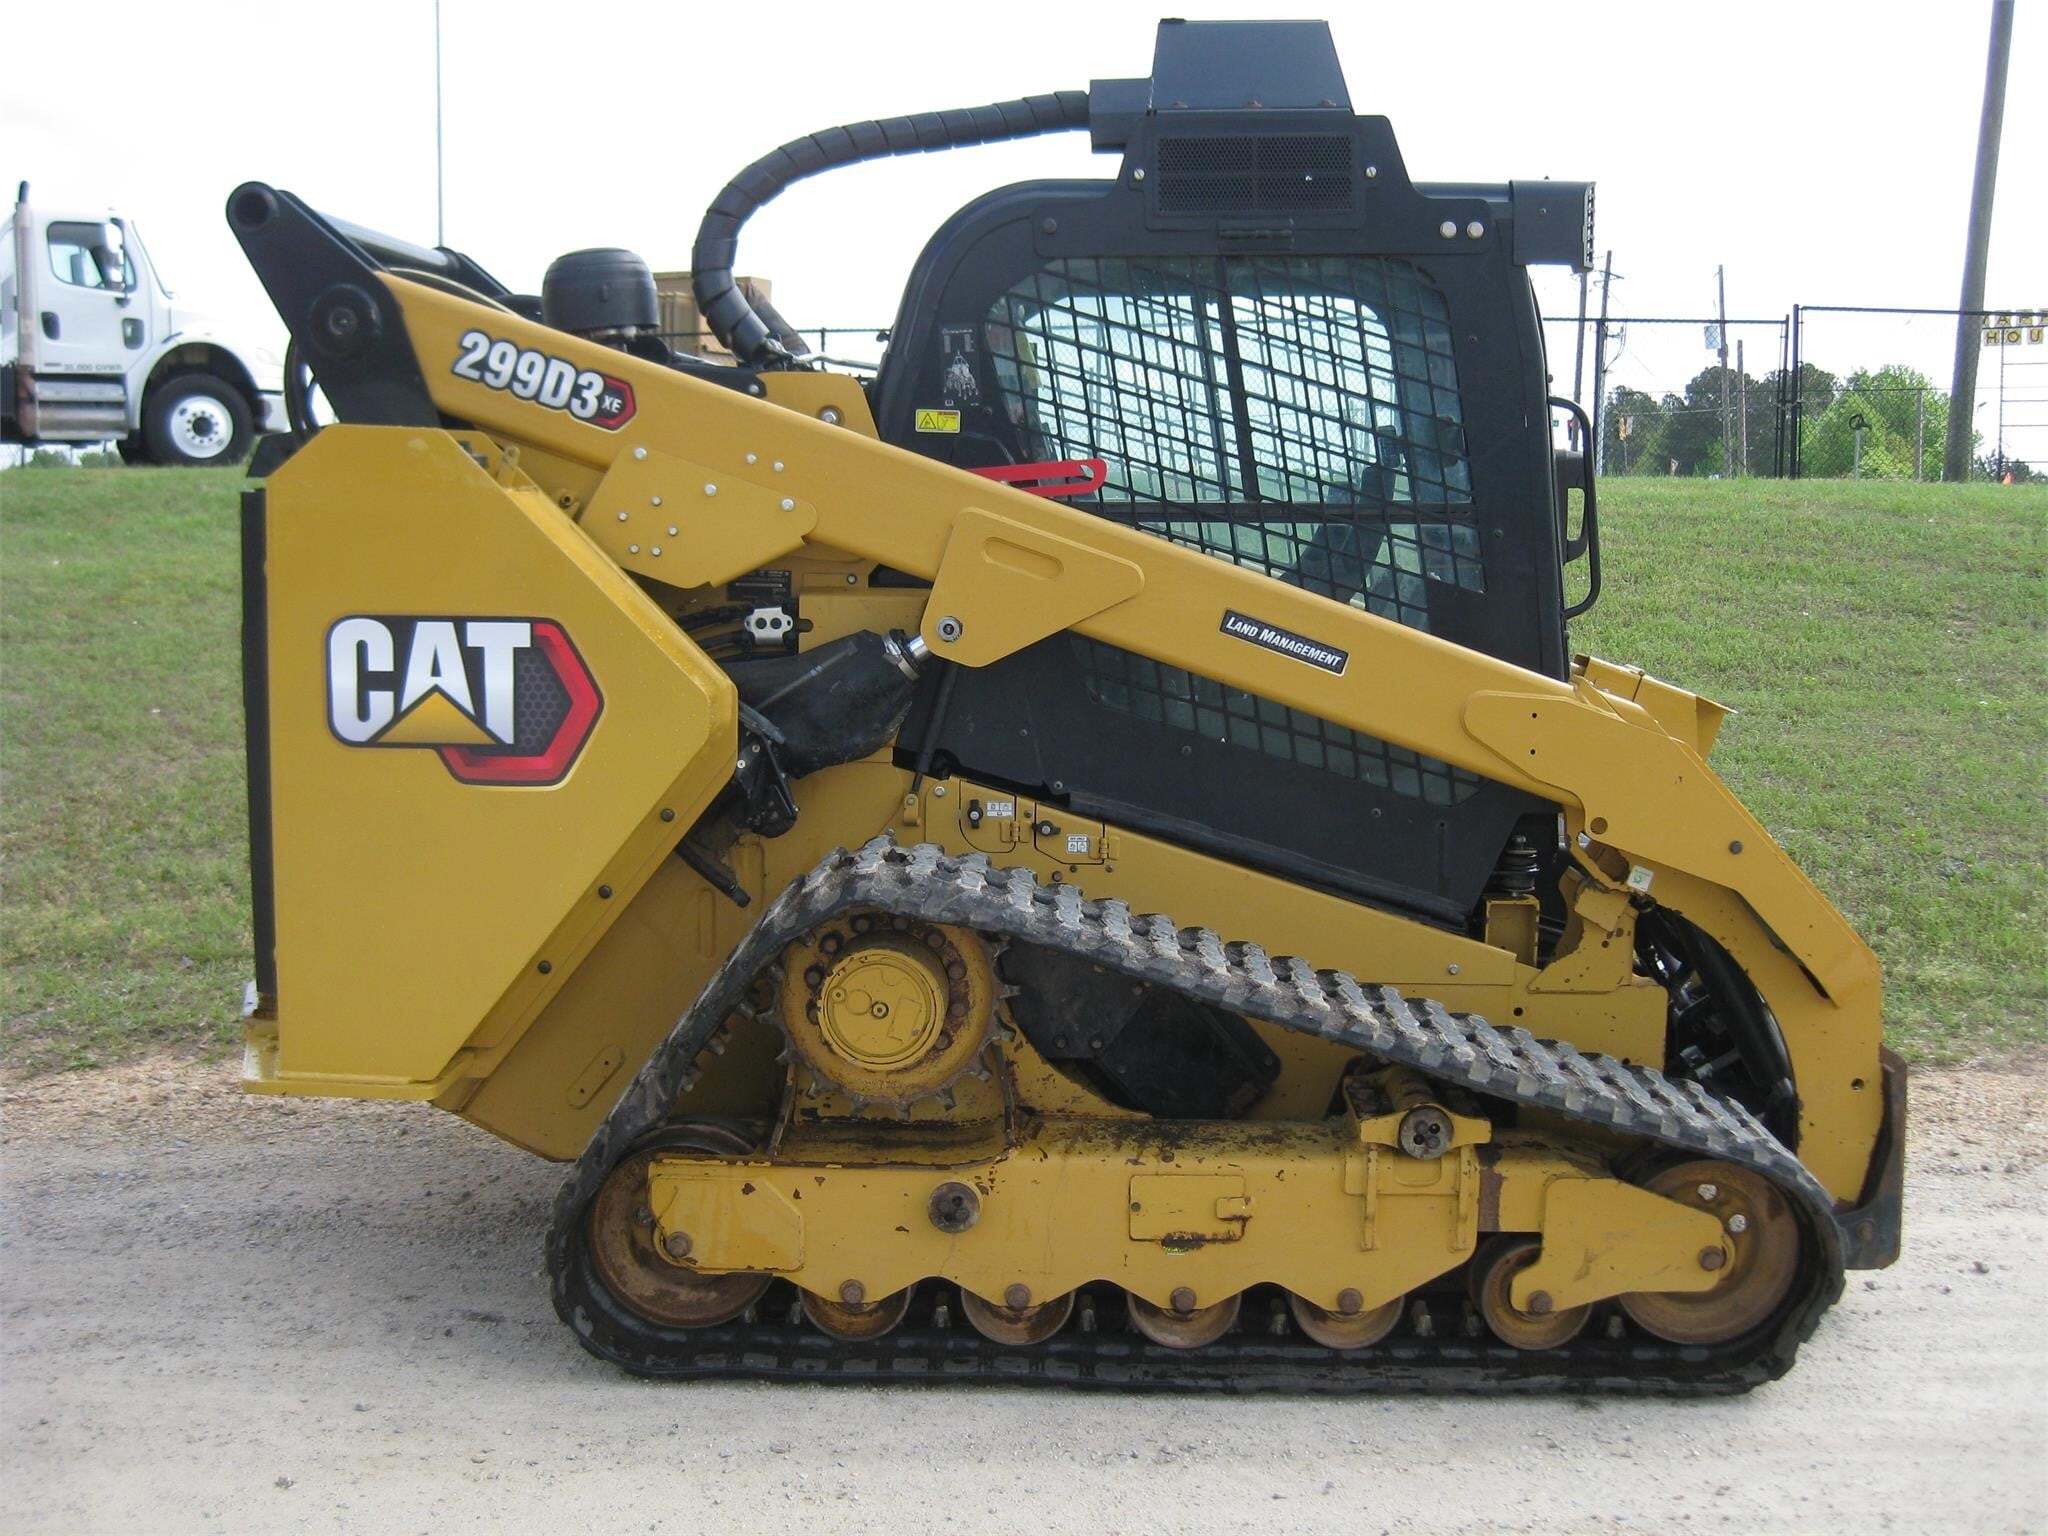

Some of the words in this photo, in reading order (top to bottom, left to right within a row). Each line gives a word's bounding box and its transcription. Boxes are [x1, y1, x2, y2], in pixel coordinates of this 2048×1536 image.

[453, 331, 604, 419] 299D3
[601, 395, 622, 413] XE
[1226, 616, 1259, 637] LAND
[1259, 628, 1342, 667] MANAGEMENT
[330, 618, 531, 745] CAT
